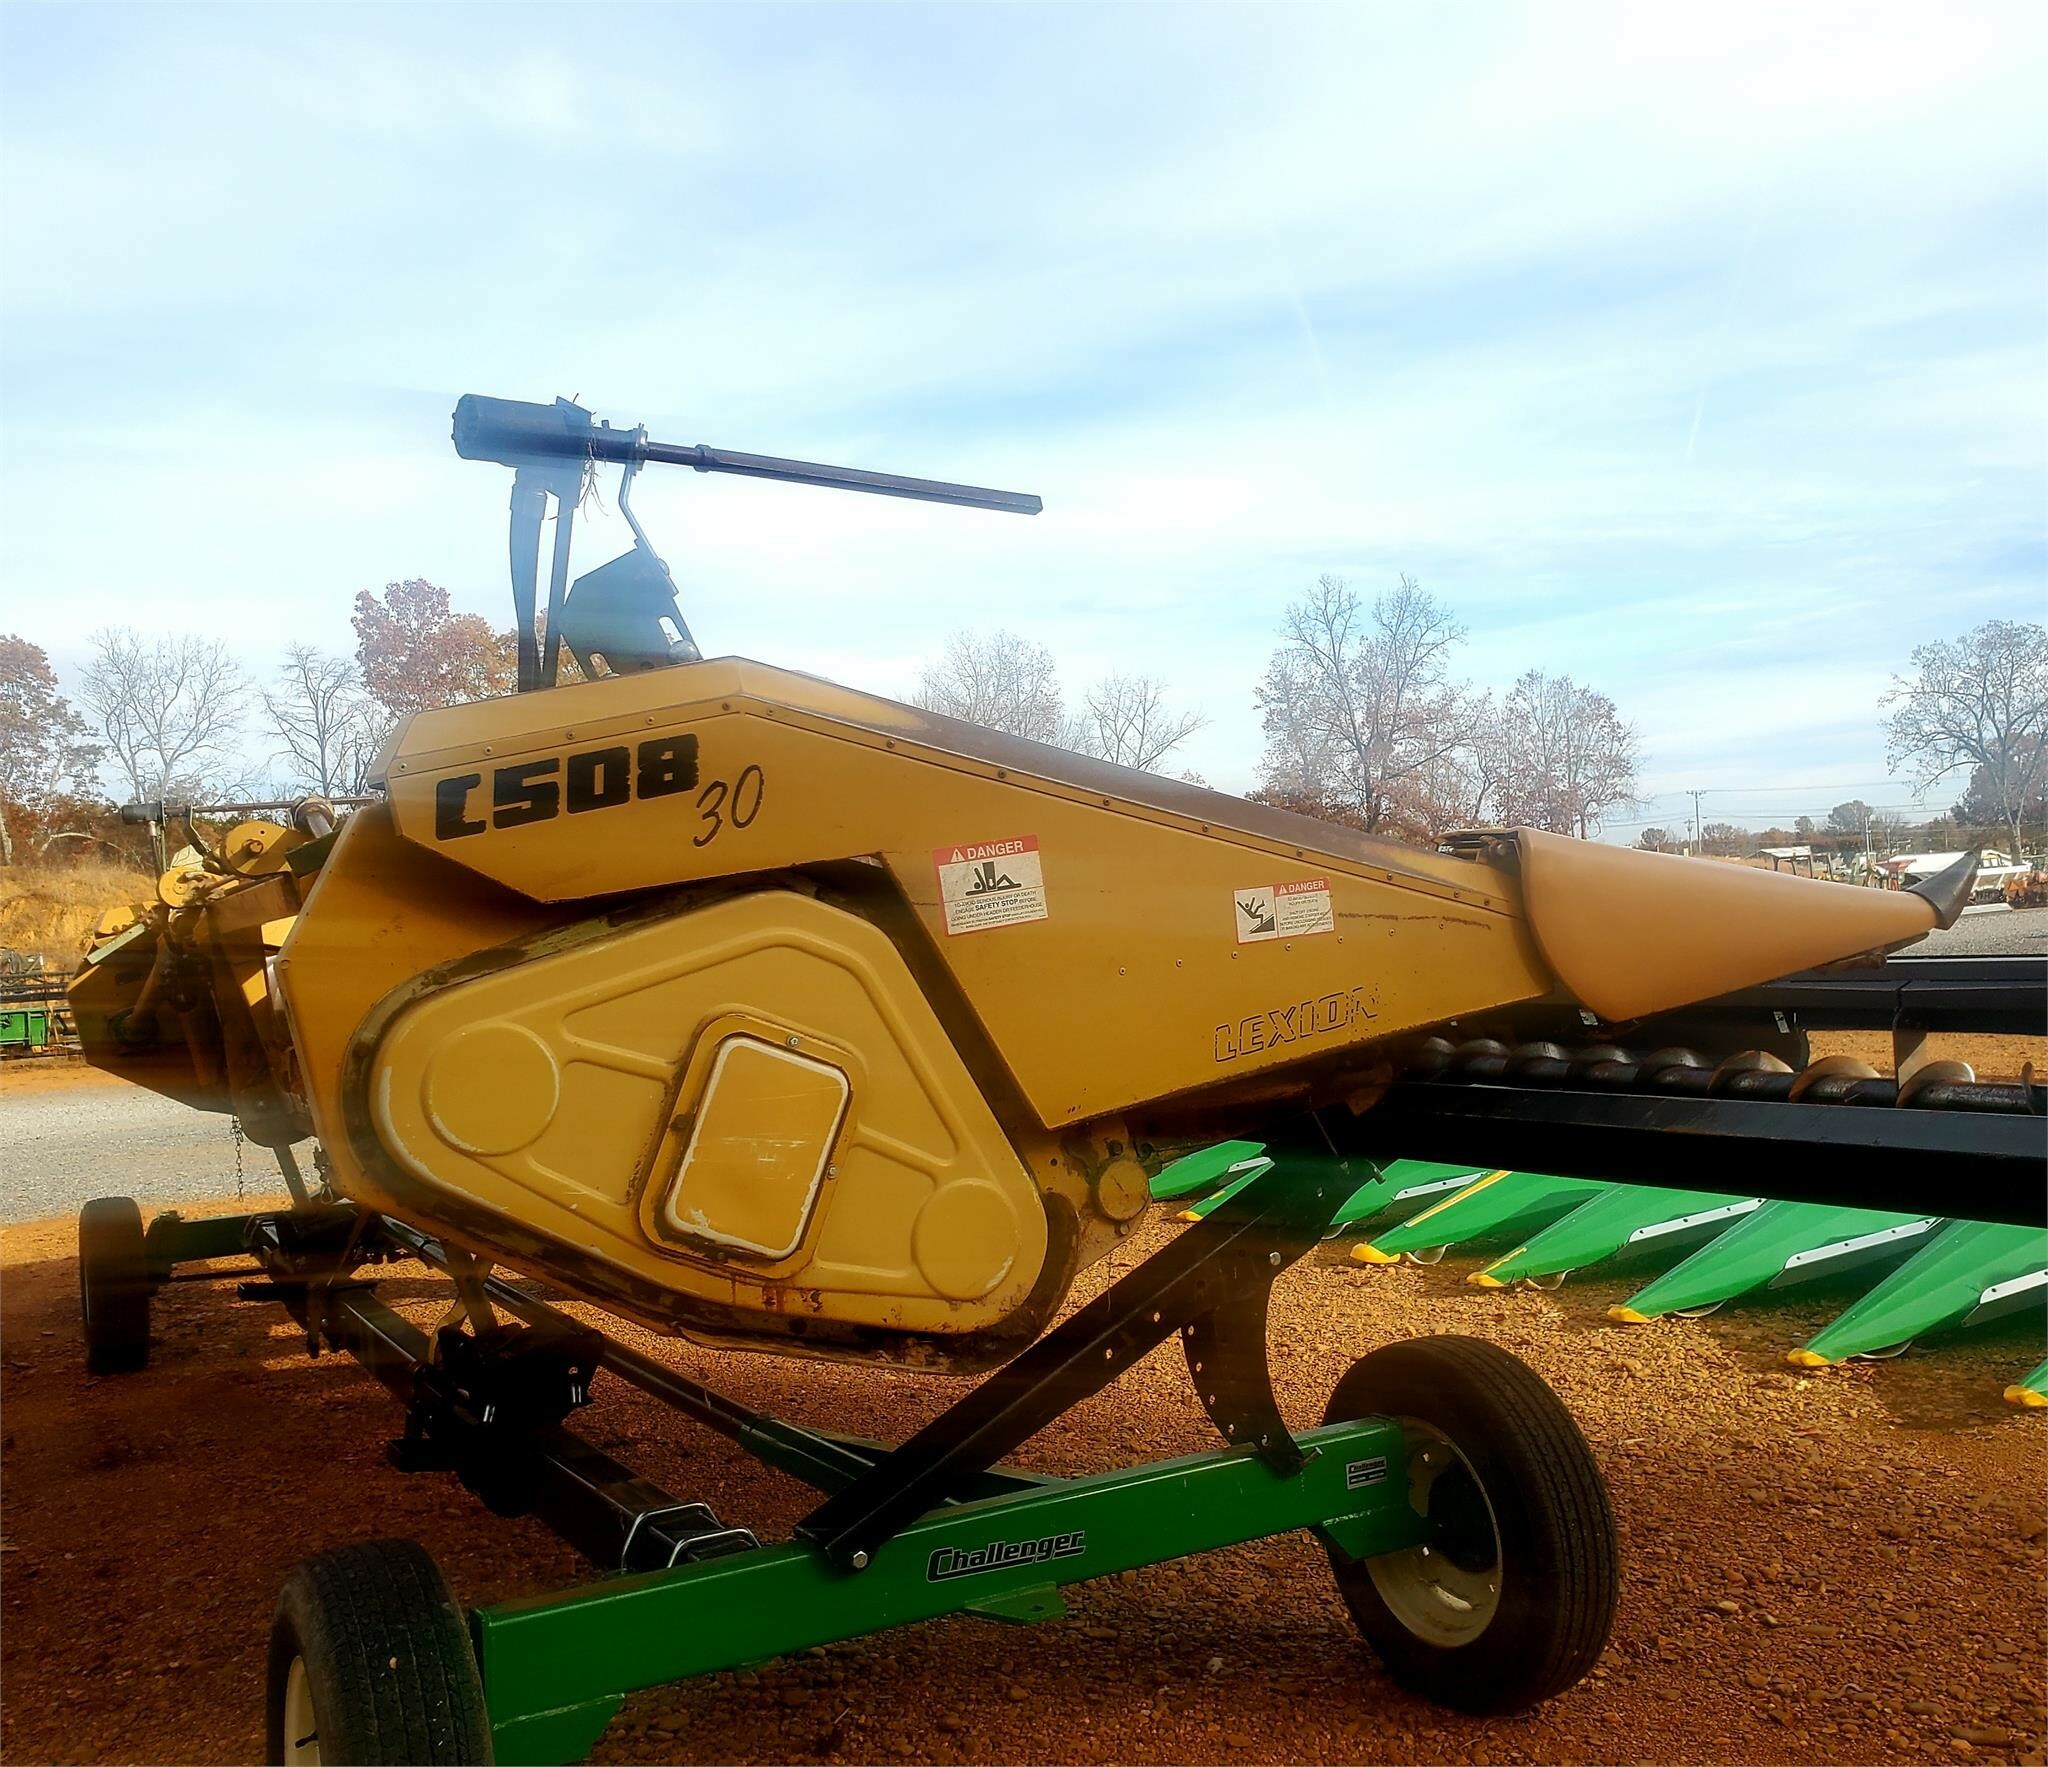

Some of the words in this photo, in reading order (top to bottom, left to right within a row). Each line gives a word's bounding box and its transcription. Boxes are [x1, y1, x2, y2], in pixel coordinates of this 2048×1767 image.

[436, 733, 699, 841] C508
[693, 764, 764, 848] 30
[967, 840, 1024, 860] DANGER
[975, 901, 1000, 911] SAFETY
[1001, 898, 1018, 907] STOP
[1288, 880, 1325, 893] DANGER
[1215, 983, 1378, 1062] LEXION
[926, 1530, 1086, 1583] Challenger
